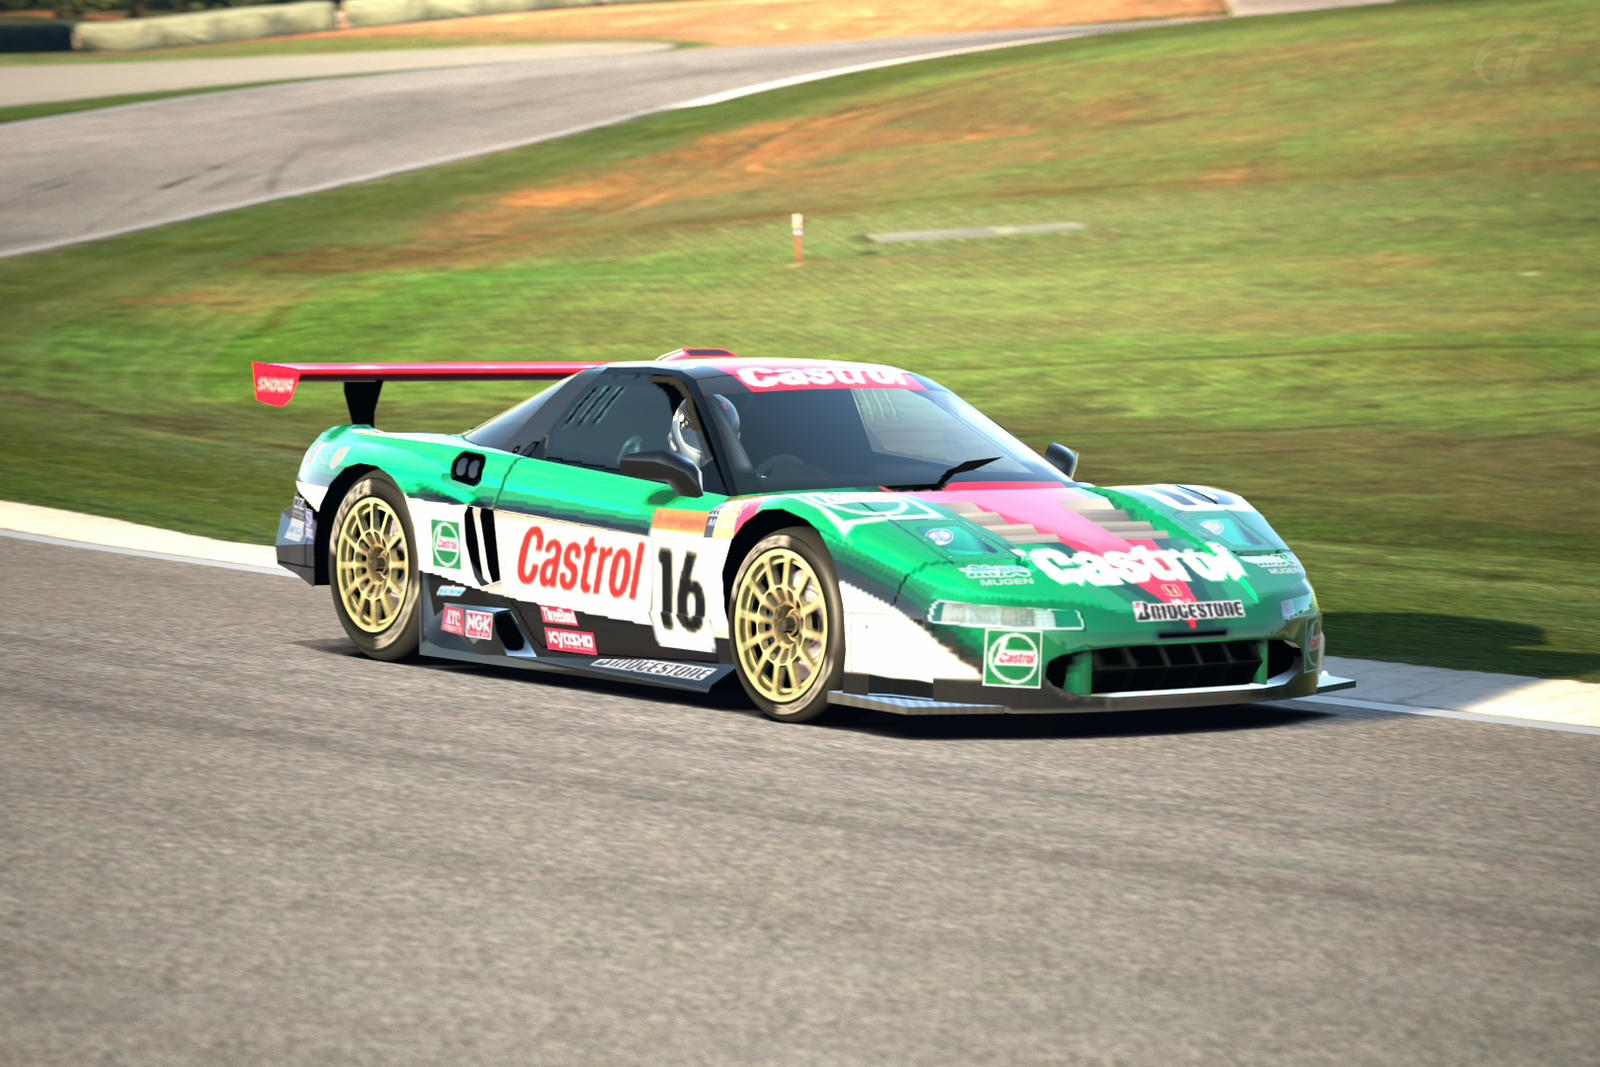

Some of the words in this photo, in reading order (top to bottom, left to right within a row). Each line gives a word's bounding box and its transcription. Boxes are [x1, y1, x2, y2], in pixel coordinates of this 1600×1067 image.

[257, 377, 294, 394] SHOWA
[737, 366, 909, 388] Castrol
[517, 526, 645, 600] Castrol
[1029, 543, 1249, 587] Castrol
[658, 546, 706, 633] 16
[980, 578, 1035, 586] MUGEN
[1135, 602, 1244, 620] BRIDGESTONE
[467, 612, 491, 633] NGK
[998, 652, 1036, 664] Castrol
[596, 659, 713, 680] BRIDGESTONE
